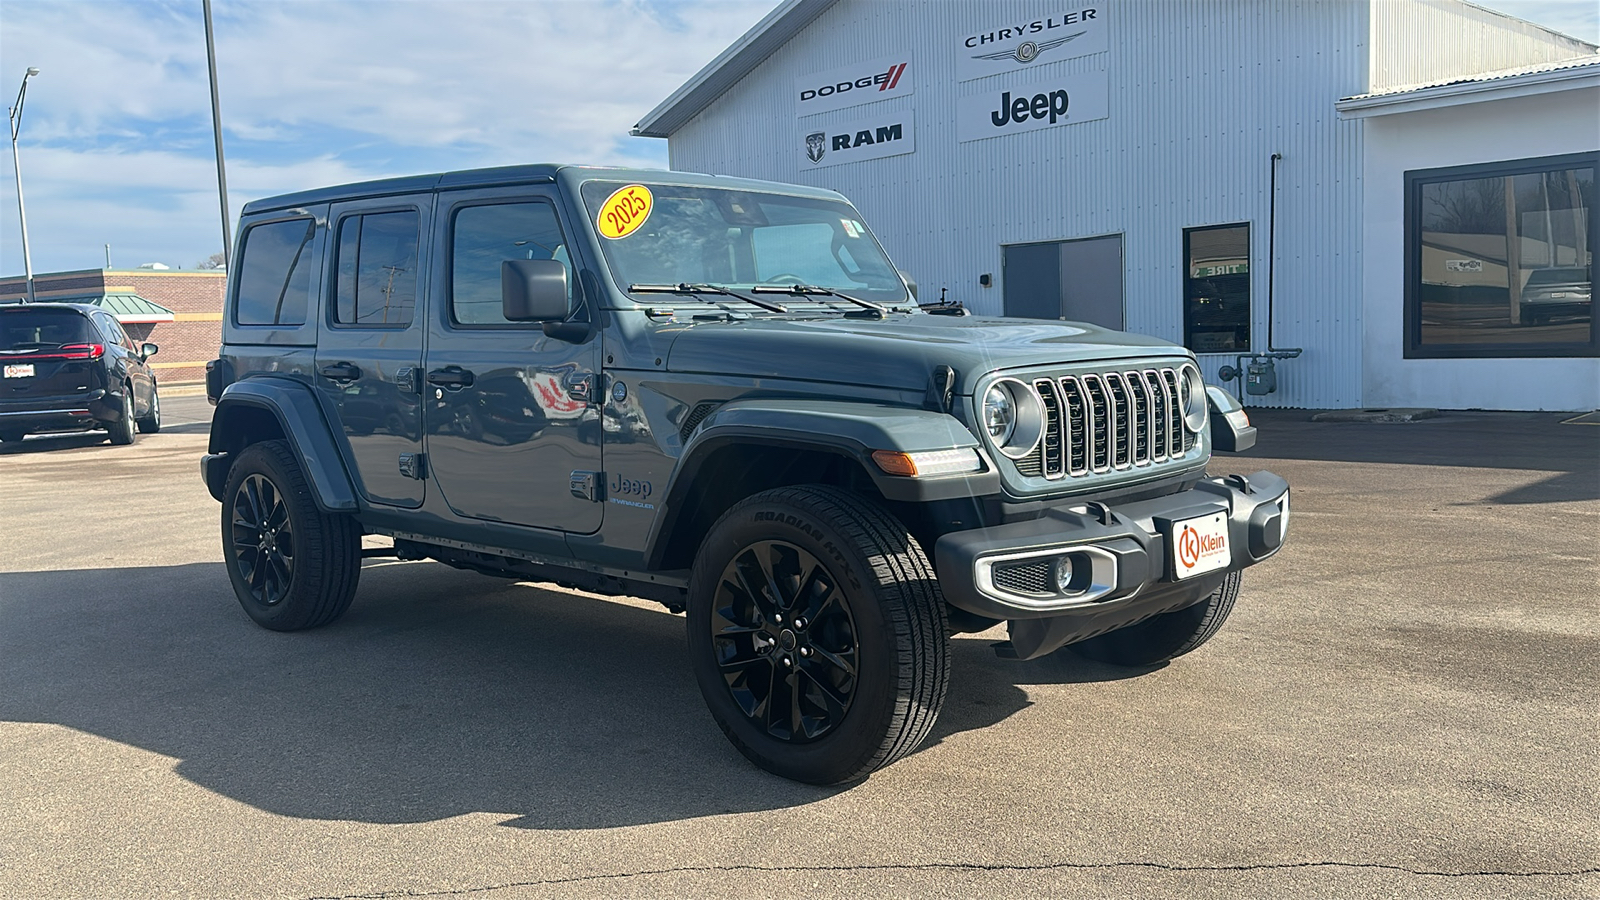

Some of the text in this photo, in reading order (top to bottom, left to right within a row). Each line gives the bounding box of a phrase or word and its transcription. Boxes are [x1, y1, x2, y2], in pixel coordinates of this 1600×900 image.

[965, 8, 1097, 48] CHRYSLER
[800, 72, 890, 102] DODGE
[991, 89, 1069, 127] Jeep
[832, 123, 903, 151] RAM
[607, 189, 646, 234] 2025
[611, 472, 653, 500] Jeep
[615, 498, 655, 510] WRANGLER
[754, 511, 825, 542] ROADIAN
[1200, 532, 1225, 553] Klein
